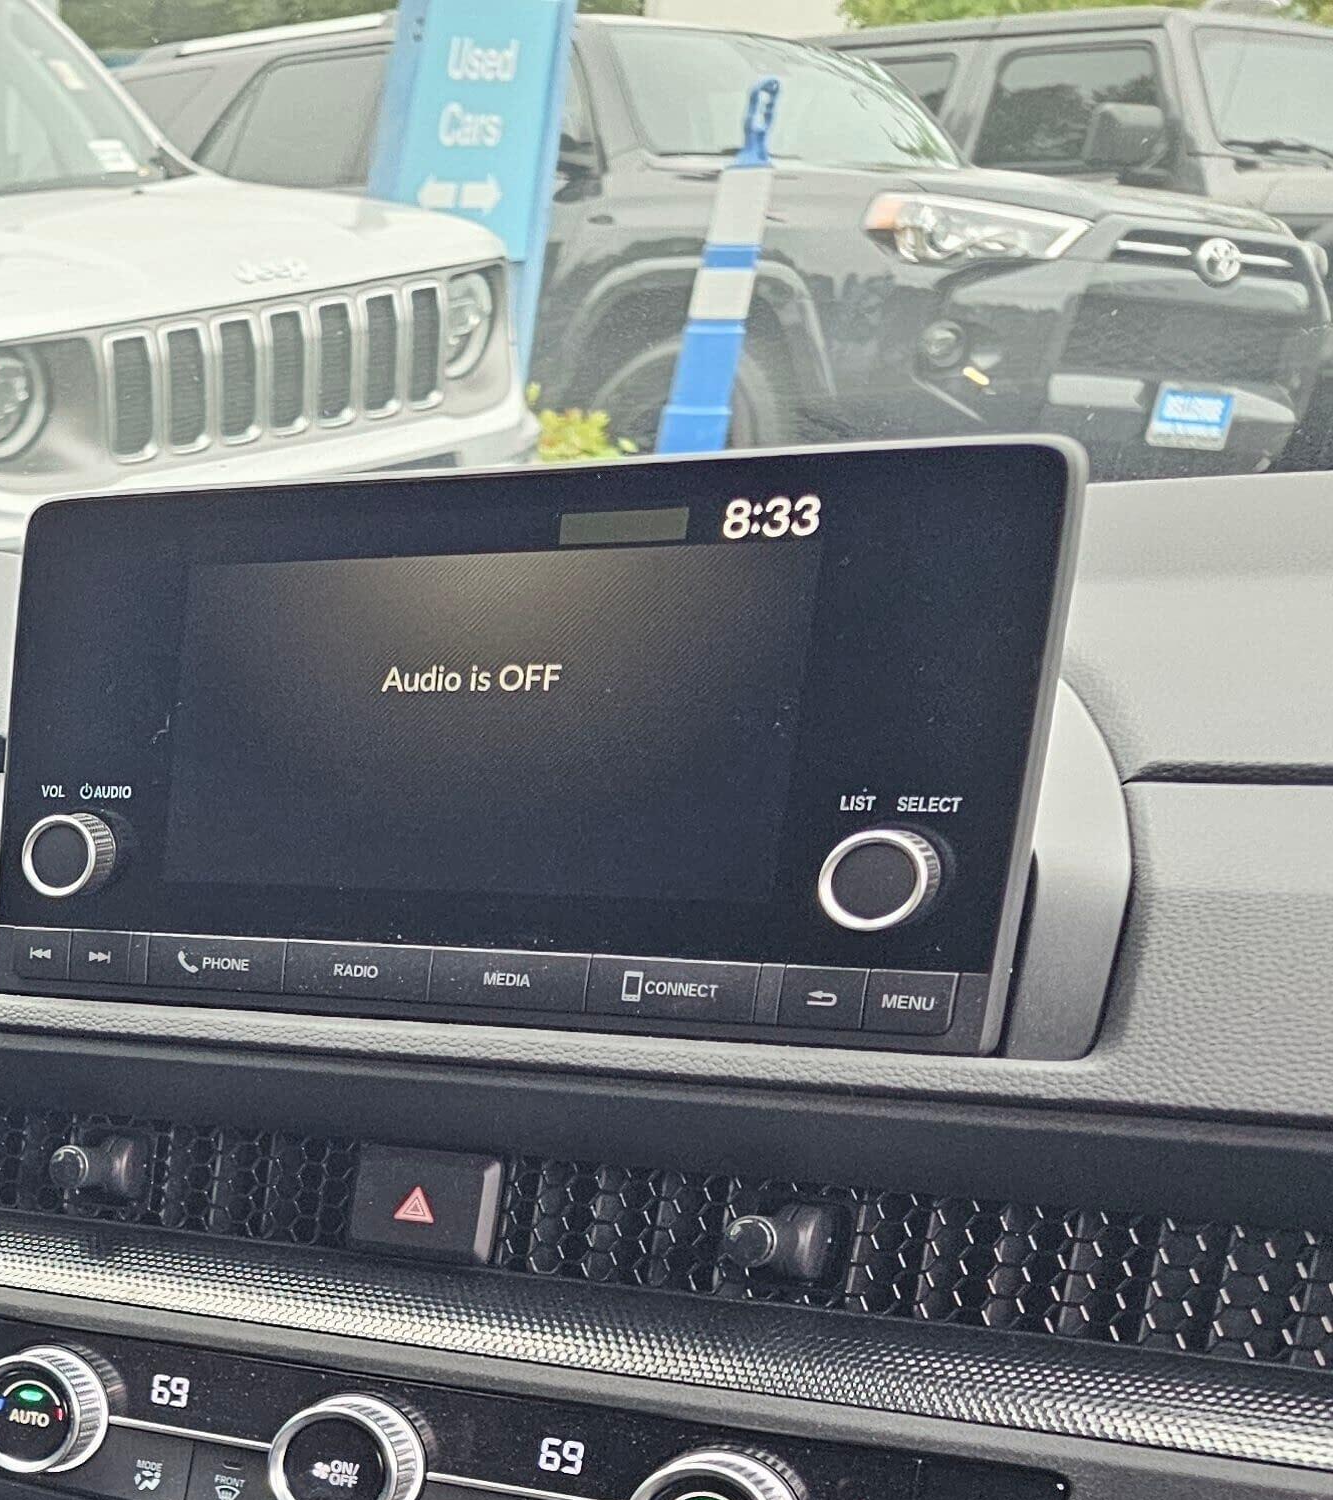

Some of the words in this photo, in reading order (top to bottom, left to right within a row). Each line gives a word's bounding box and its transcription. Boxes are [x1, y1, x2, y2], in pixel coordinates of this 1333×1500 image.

[448, 35, 520, 82] Used
[438, 101, 503, 147] Cars
[232, 257, 309, 285] Jeep
[722, 495, 822, 540] 8:33
[381, 663, 462, 692] Audio
[469, 664, 492, 692] is
[498, 663, 563, 692] OFF
[41, 784, 66, 798] VOL
[93, 785, 132, 799] AUDIO
[839, 794, 877, 812] LIST
[896, 796, 963, 813] SELECT
[202, 956, 251, 972] PHONE
[333, 963, 379, 979] RADIO
[483, 971, 531, 988] MEDIA
[644, 980, 719, 999] CONNECT
[881, 993, 935, 1011] MENU
[150, 1374, 190, 1408] 69
[9, 1408, 50, 1428] AUTO
[136, 1459, 163, 1472] MODE
[538, 1437, 584, 1475] 69
[330, 1459, 360, 1475] ON/
[214, 1474, 246, 1488] FRONT
[328, 1473, 359, 1488] OFF
